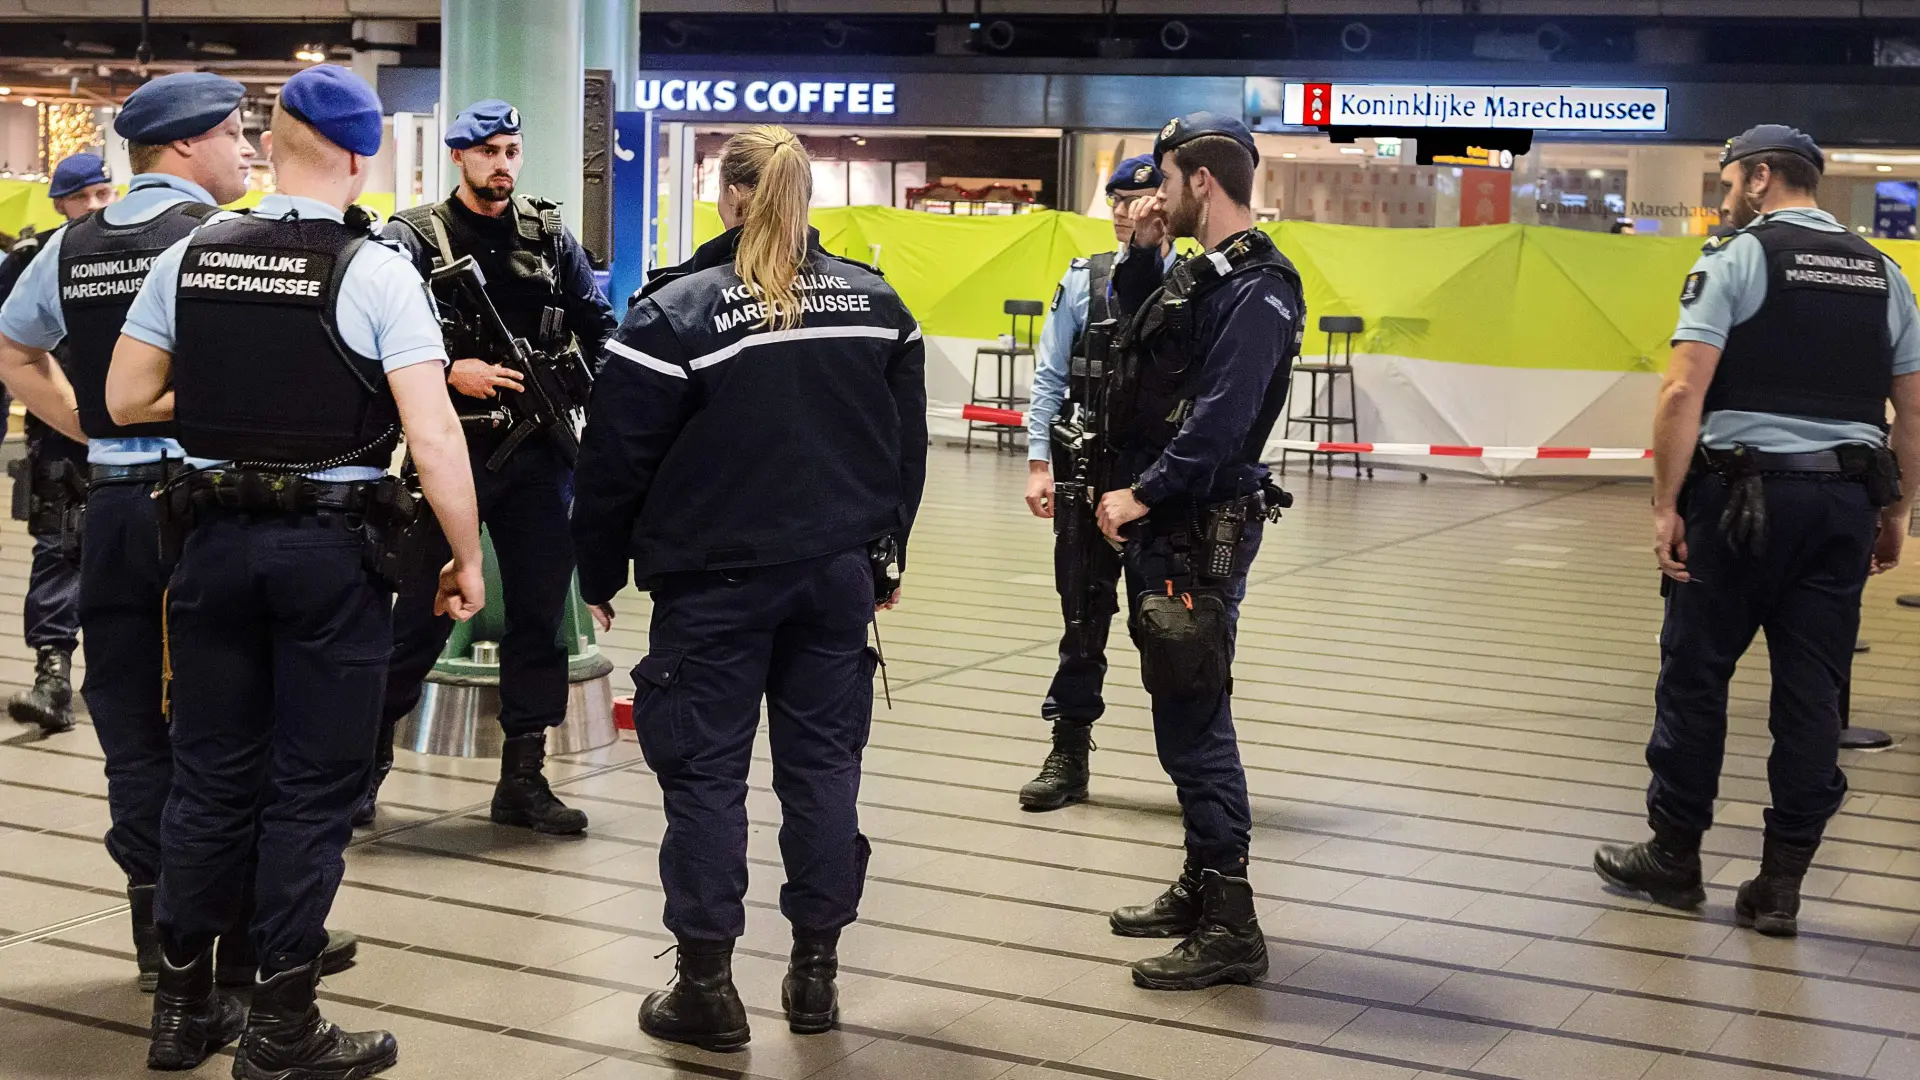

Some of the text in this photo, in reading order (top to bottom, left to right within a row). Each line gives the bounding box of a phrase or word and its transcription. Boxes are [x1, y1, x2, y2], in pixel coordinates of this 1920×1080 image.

[635, 79, 895, 114] UCKS COFFEE
[1341, 91, 1656, 123] Koninklijke Marechaussee
[199, 251, 308, 273] KONINKLIJKE
[1794, 253, 1877, 273] KONINKLIJKE
[180, 272, 321, 297] MARECHAUSSEE
[1785, 269, 1888, 290] MARECHAUSSEE
